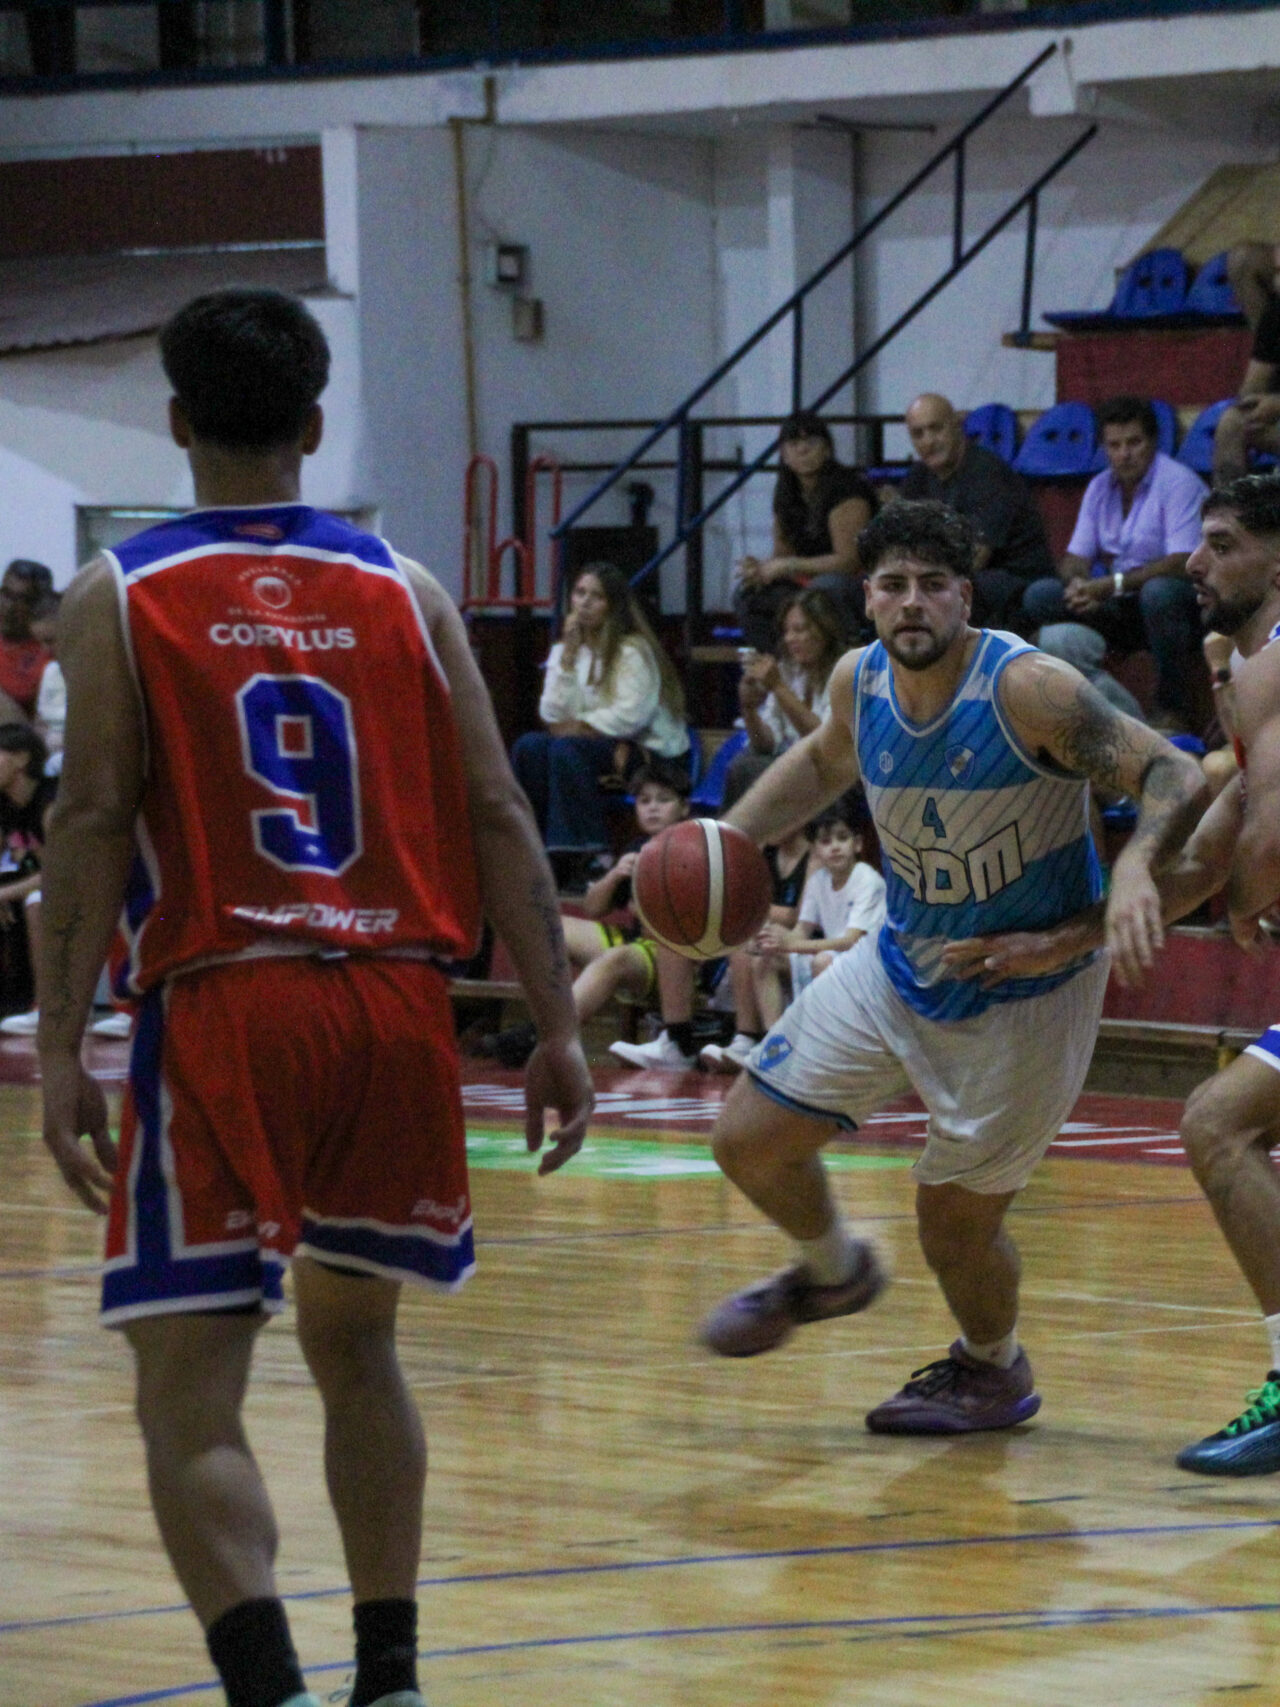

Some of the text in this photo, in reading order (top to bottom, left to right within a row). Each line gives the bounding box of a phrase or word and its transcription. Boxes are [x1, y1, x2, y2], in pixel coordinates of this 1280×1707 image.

[209, 622, 357, 652] CORYLUS
[234, 672, 364, 878] 9
[921, 796, 947, 839] 4
